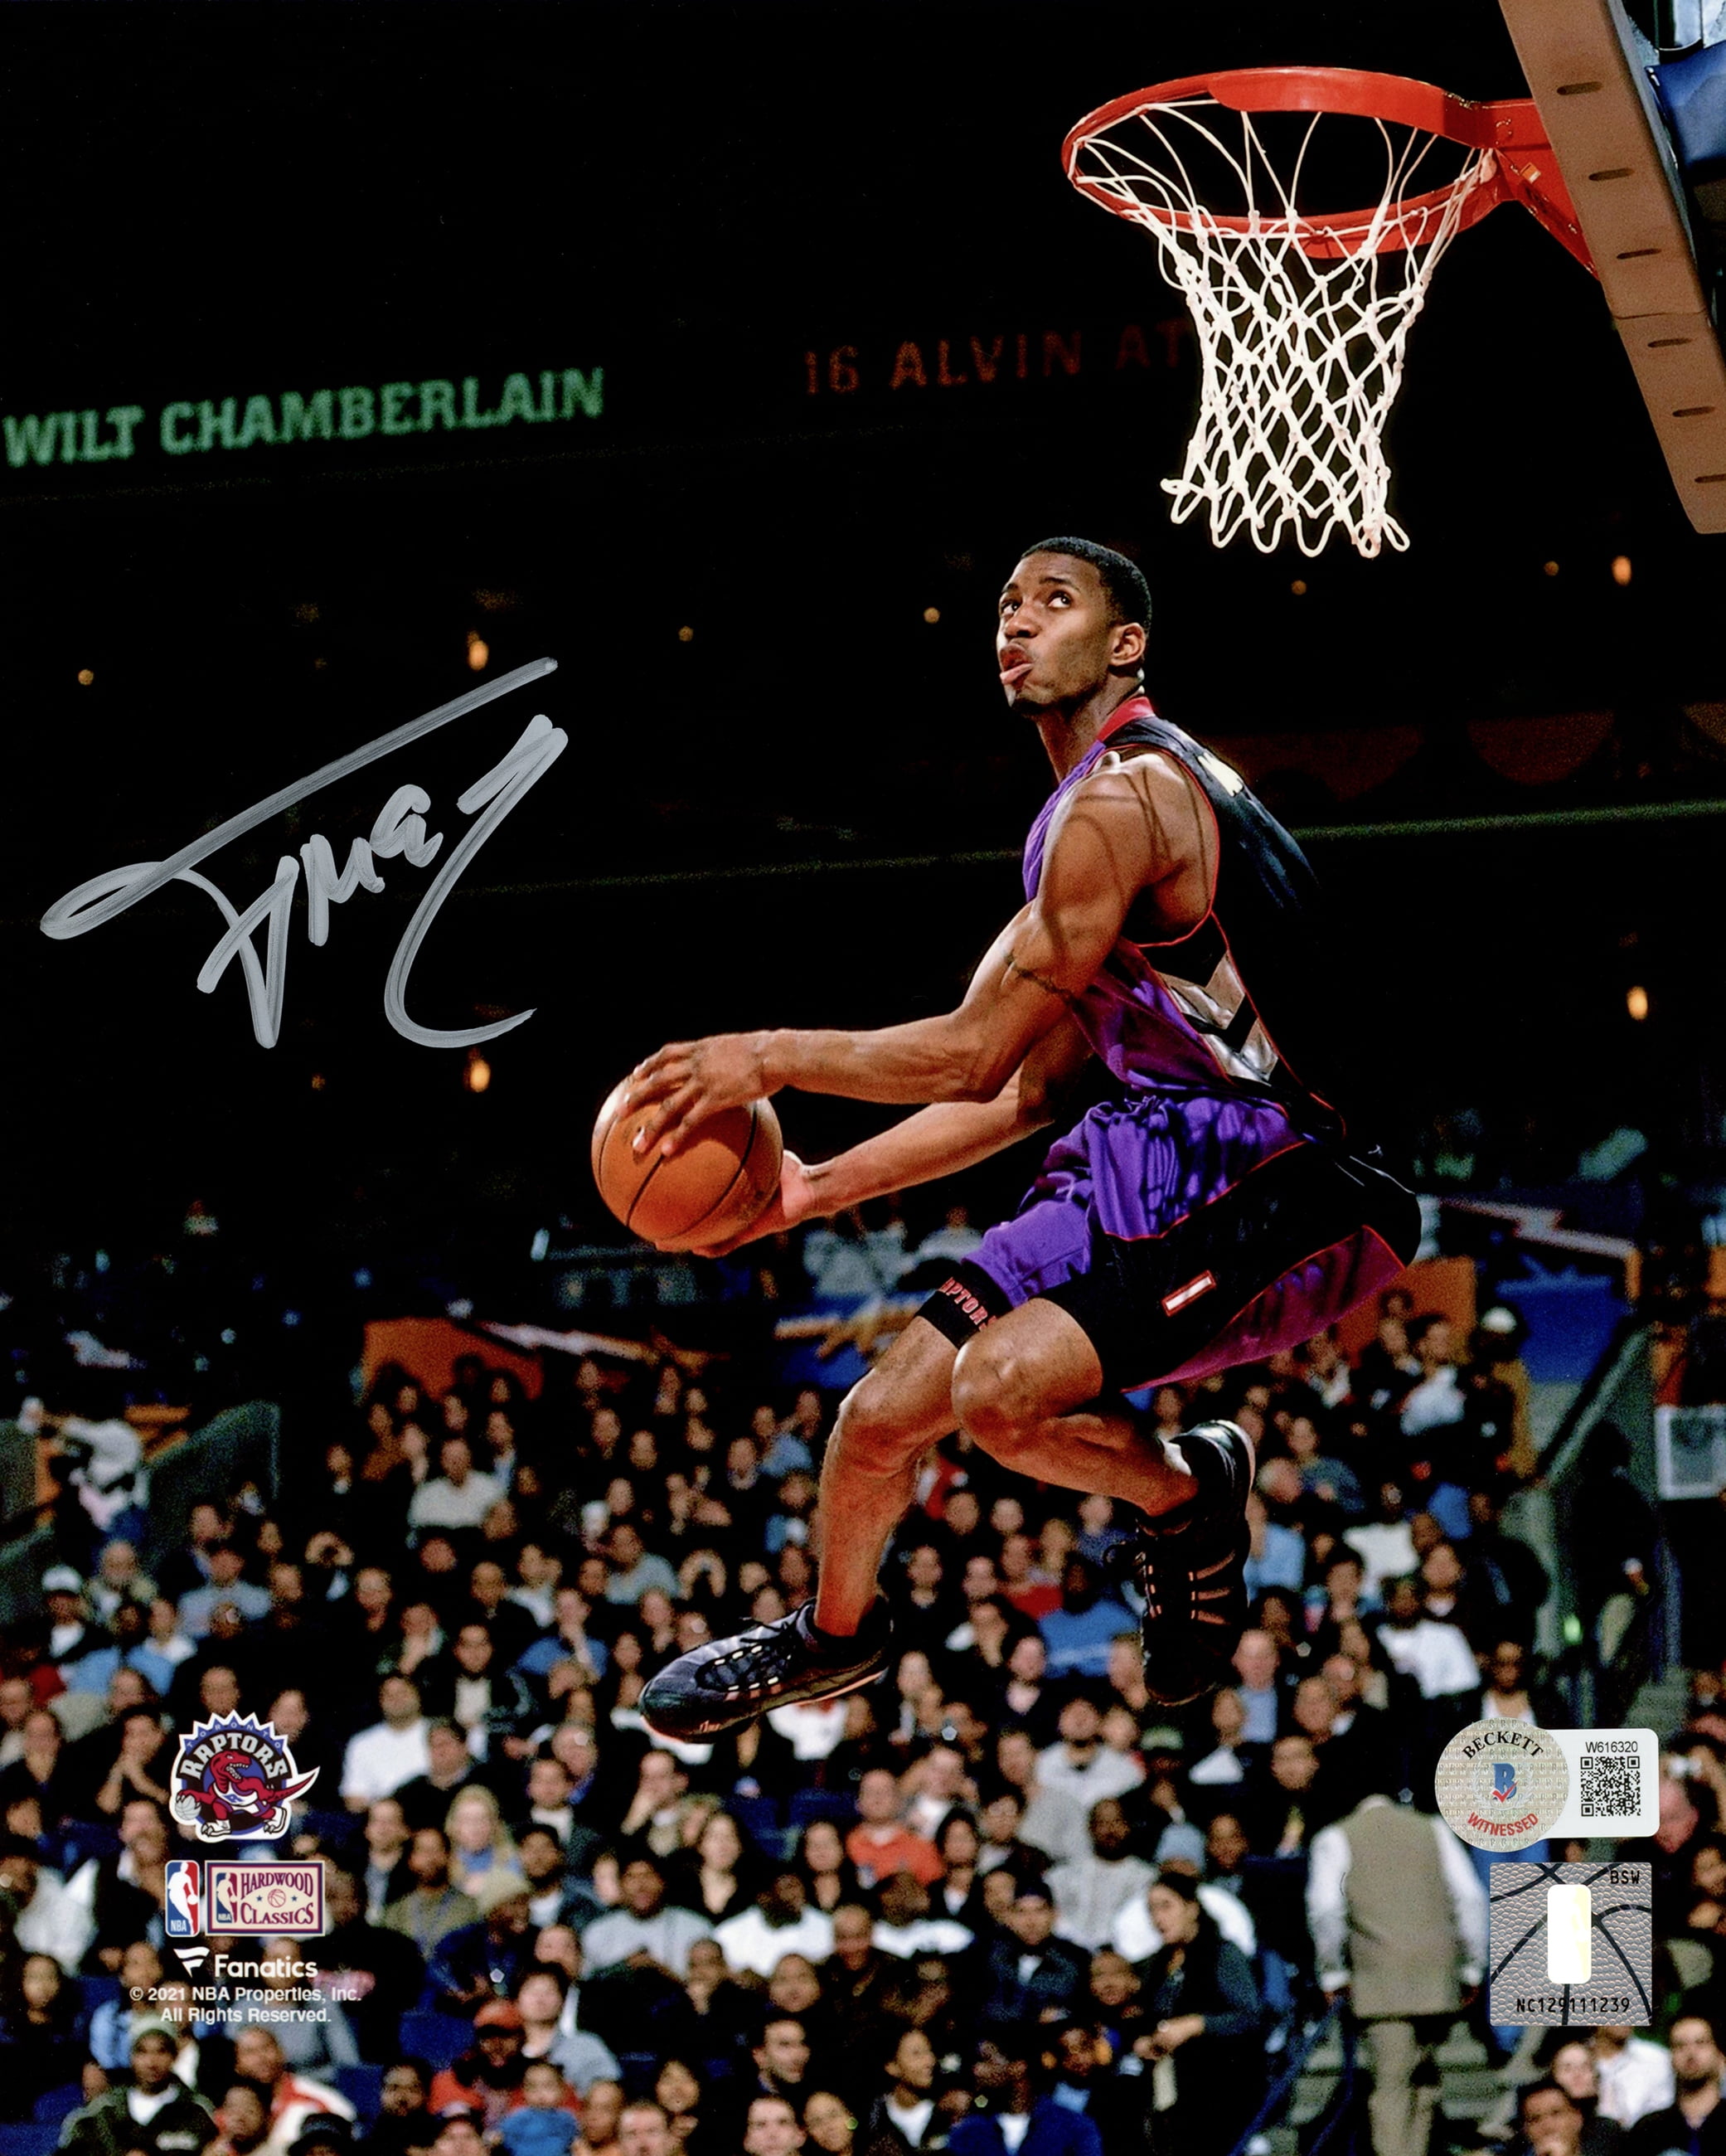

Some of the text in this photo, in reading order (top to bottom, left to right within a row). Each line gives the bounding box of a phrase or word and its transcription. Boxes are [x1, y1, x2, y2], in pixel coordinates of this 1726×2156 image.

[802, 343, 859, 396] 16
[888, 332, 1082, 391] ALVIN
[2, 365, 605, 468] WILT CHAMBERLAIN
